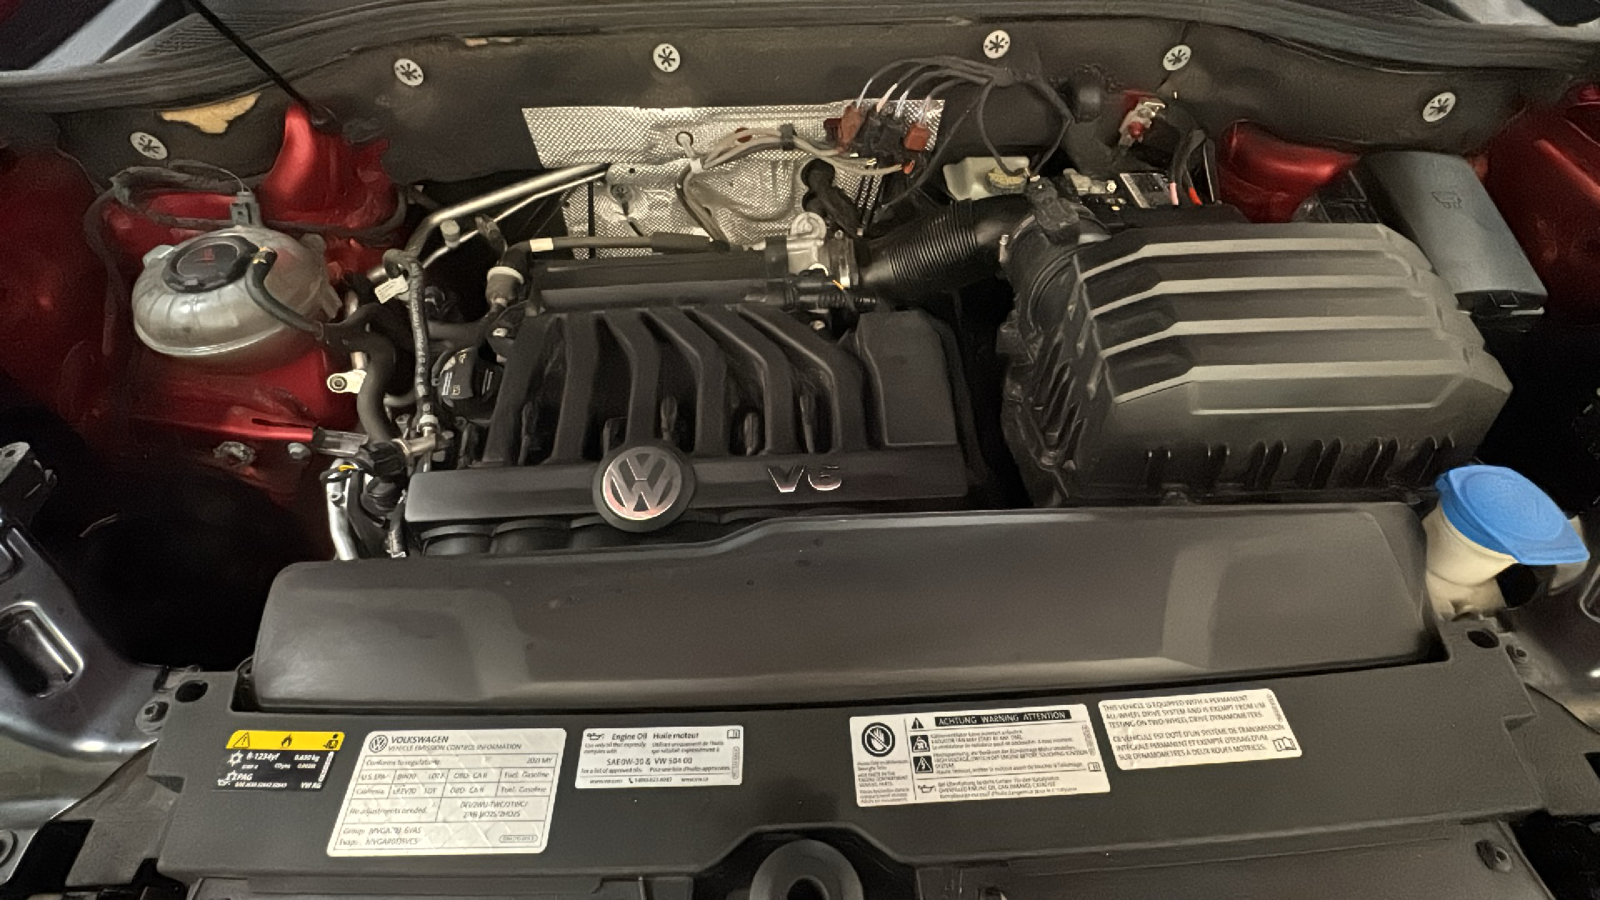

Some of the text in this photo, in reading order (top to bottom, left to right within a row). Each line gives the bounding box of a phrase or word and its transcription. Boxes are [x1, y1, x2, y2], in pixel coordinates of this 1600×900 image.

[767, 465, 842, 493] V6
[1161, 708, 1185, 716] SYSTEM
[938, 711, 1066, 726] ACHTUNG WARNING ATTENTION
[391, 735, 449, 744] VOLKSWAGEN
[611, 732, 648, 742] Engine Oil
[388, 744, 413, 752] VEHICLE
[446, 743, 475, 751] CONTROL
[477, 743, 522, 751] INFORMATION
[606, 758, 620, 766] SAE
[620, 757, 644, 766] 0W-30
[237, 772, 253, 781] PAG
